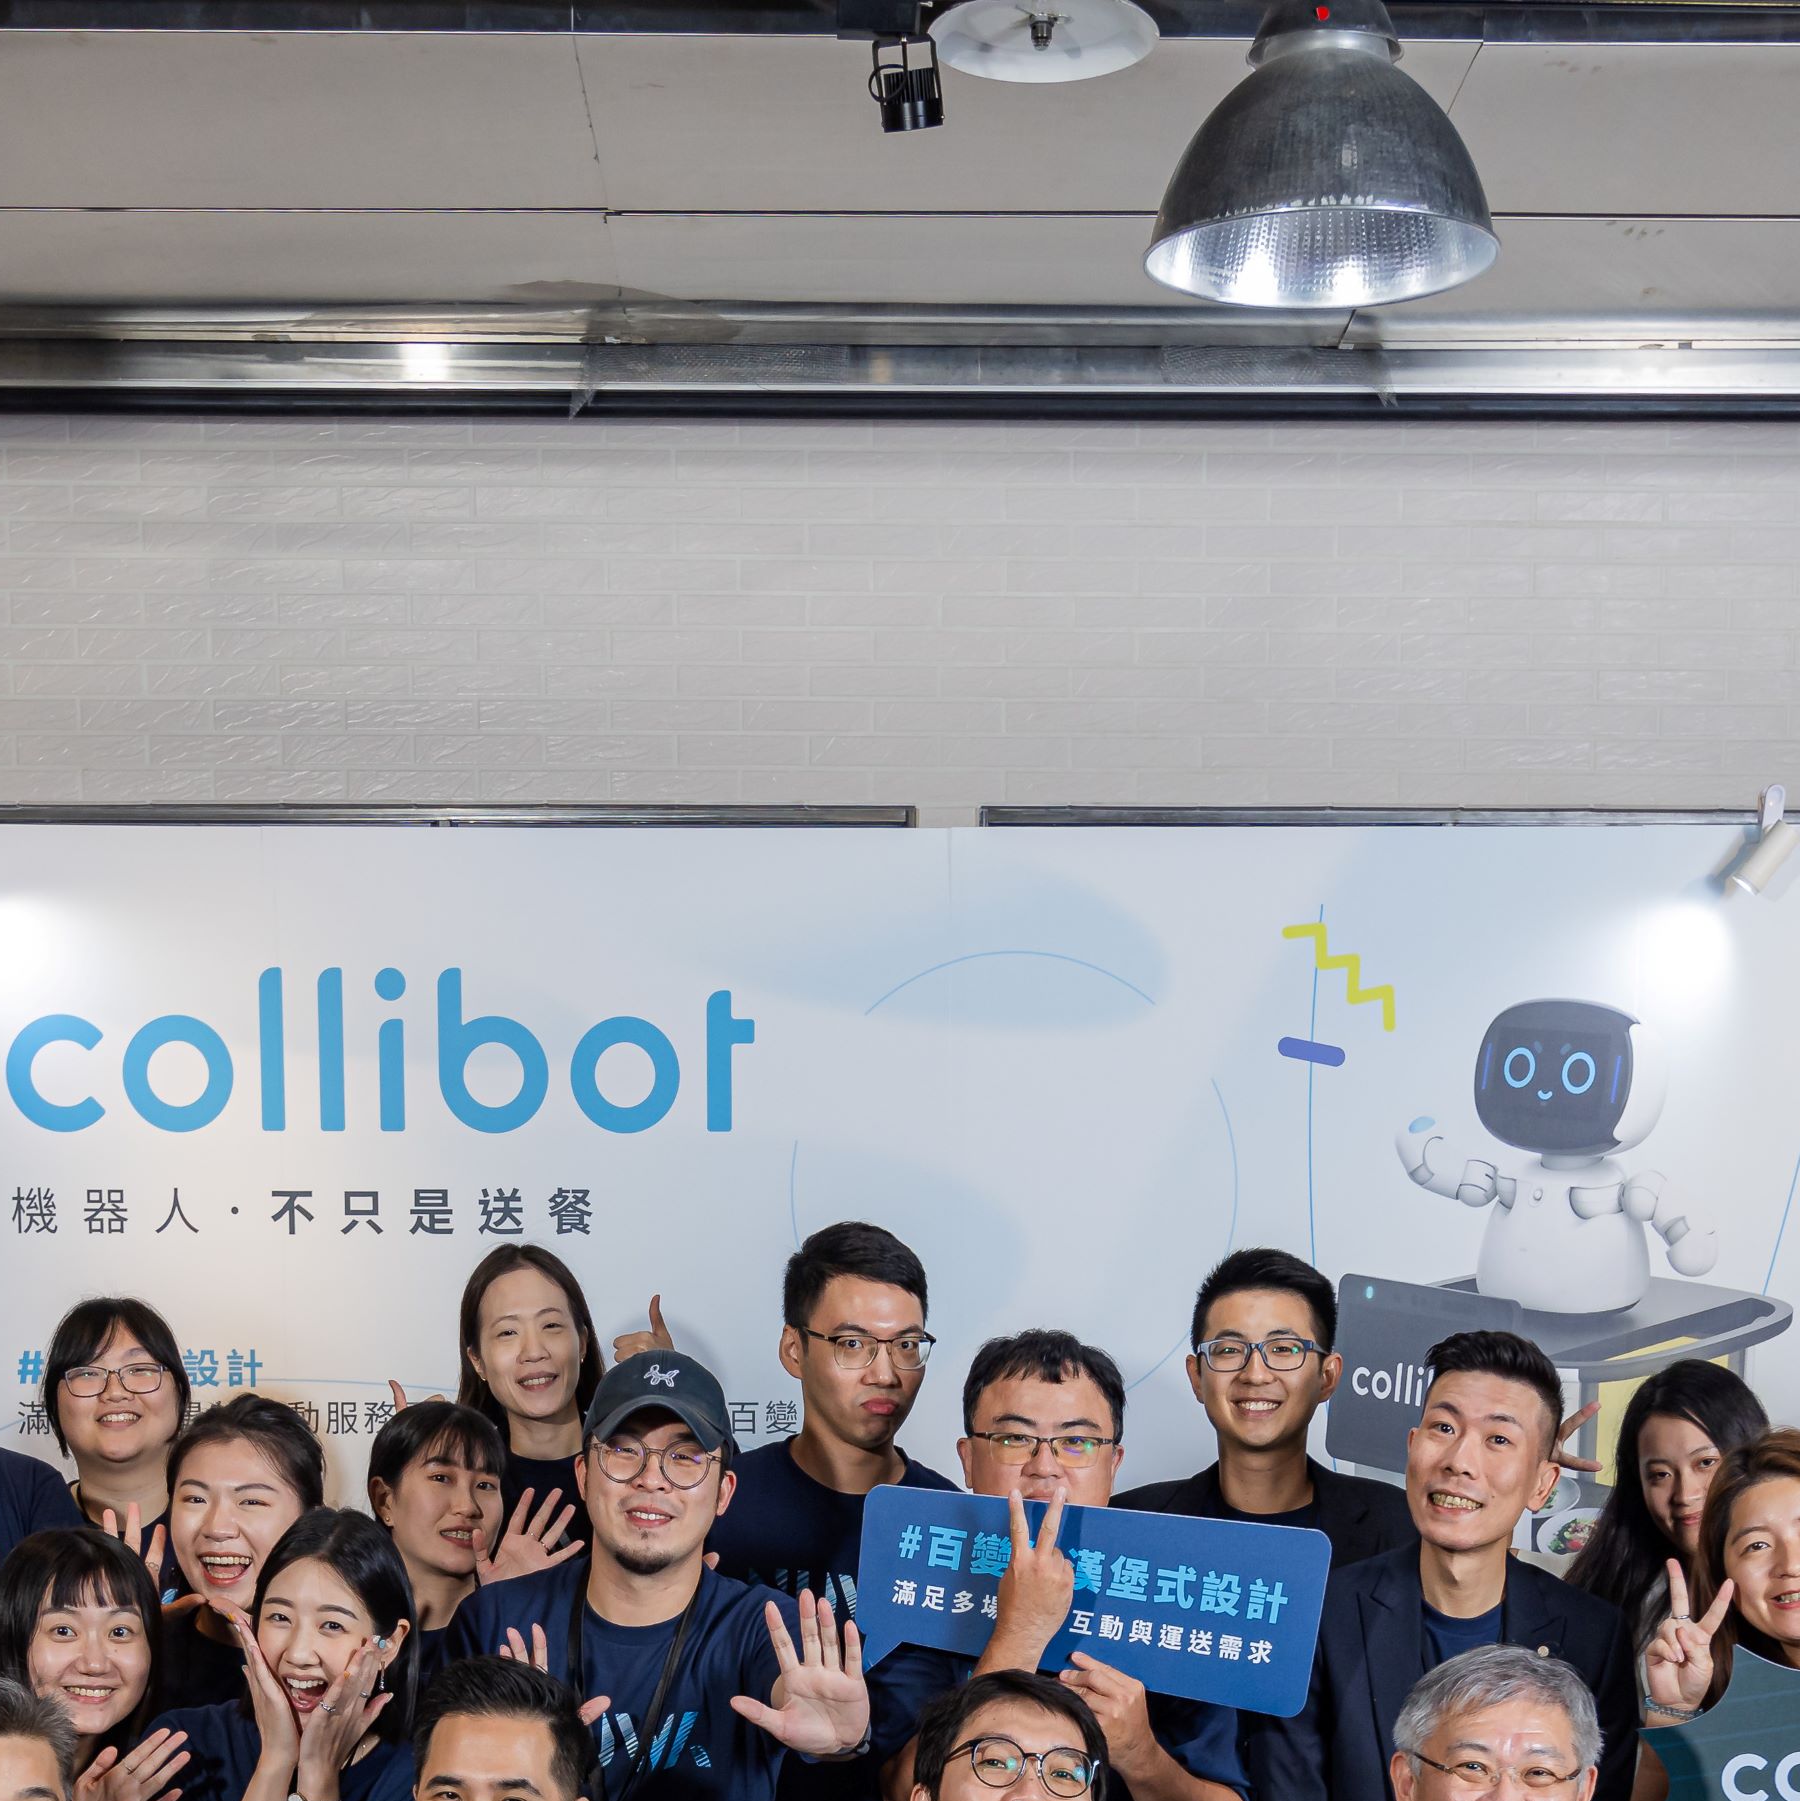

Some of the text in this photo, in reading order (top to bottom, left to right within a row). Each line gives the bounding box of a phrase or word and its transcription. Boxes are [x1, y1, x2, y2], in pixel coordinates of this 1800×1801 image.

[6, 966, 755, 1134] collibot
[1351, 1362, 1436, 1407] colli
[899, 1524, 1289, 1625] #百變漢堡式設計
[891, 1579, 1274, 1665] 滿足多場互動與運送需求
